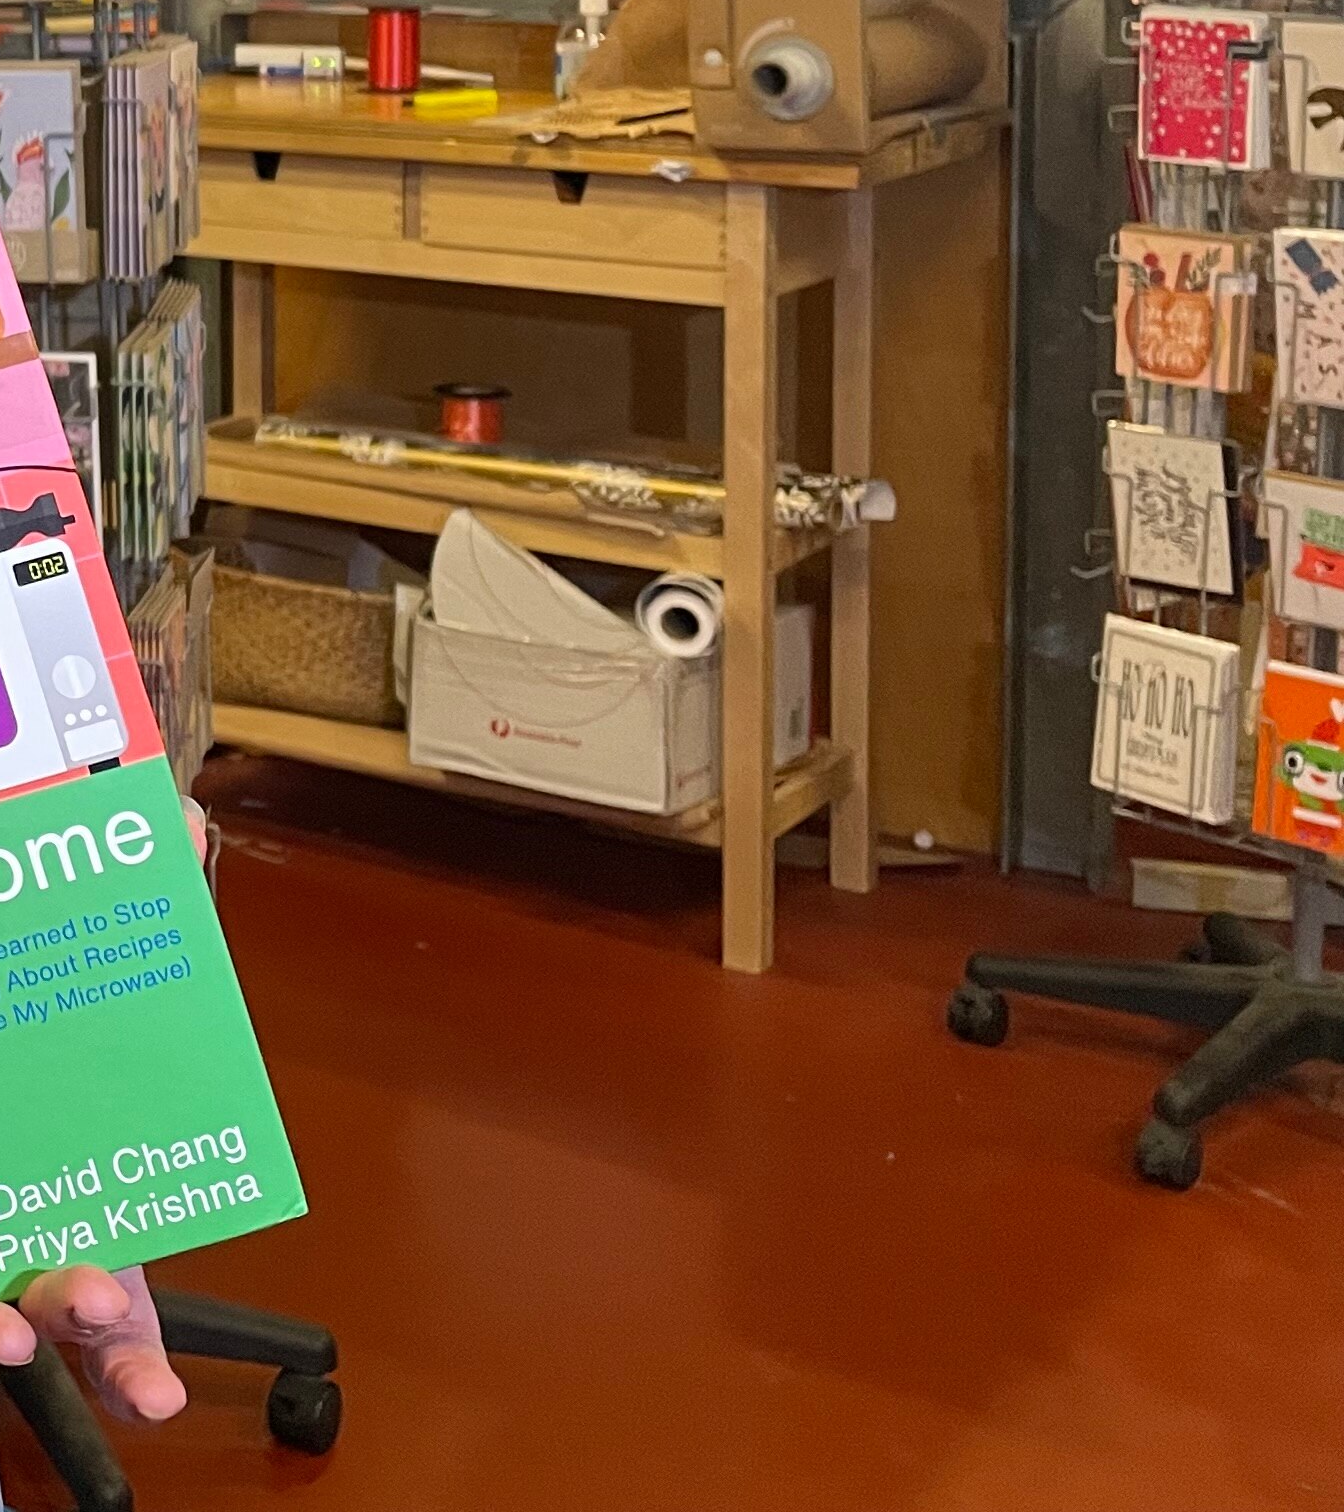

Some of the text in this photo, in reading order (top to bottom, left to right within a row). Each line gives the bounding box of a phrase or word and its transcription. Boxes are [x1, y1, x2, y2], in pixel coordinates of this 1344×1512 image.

[28, 555, 65, 580] 0:02
[83, 915, 108, 935] to
[113, 897, 171, 925] Stop
[8, 954, 80, 993] About
[83, 929, 182, 970] Recipes
[12, 1000, 49, 1025] My
[55, 955, 191, 1013] Microwave)
[112, 1125, 248, 1185] Chang
[102, 1173, 264, 1240] Krishna
